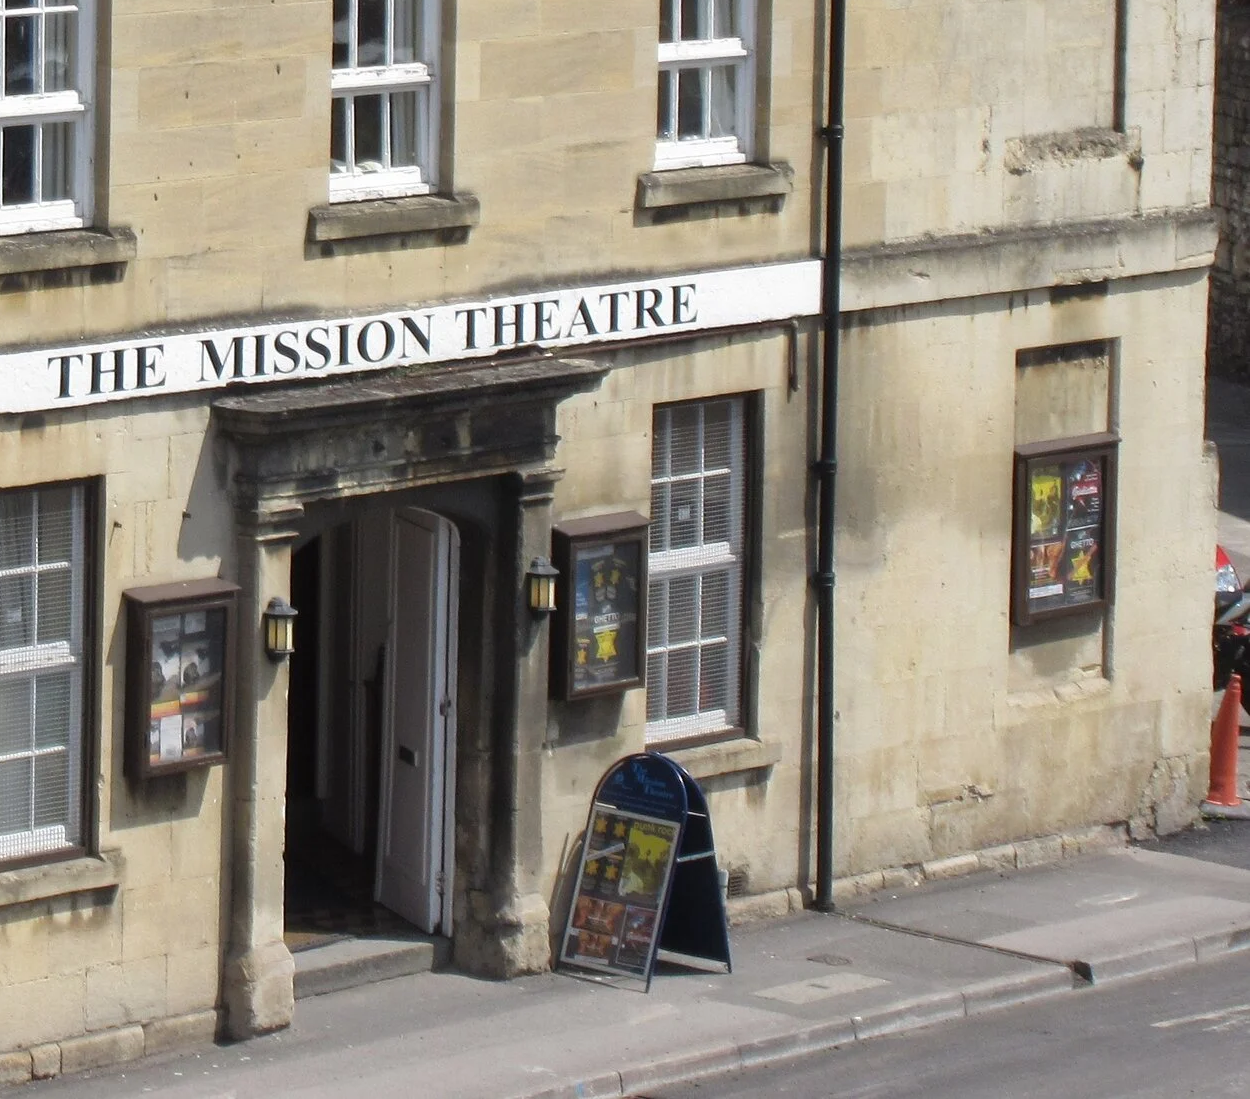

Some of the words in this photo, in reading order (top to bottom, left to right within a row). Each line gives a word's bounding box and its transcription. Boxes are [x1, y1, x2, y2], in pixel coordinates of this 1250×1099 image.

[47, 344, 167, 399] THE
[196, 313, 435, 383] MISSION
[454, 283, 699, 350] THEATRE
